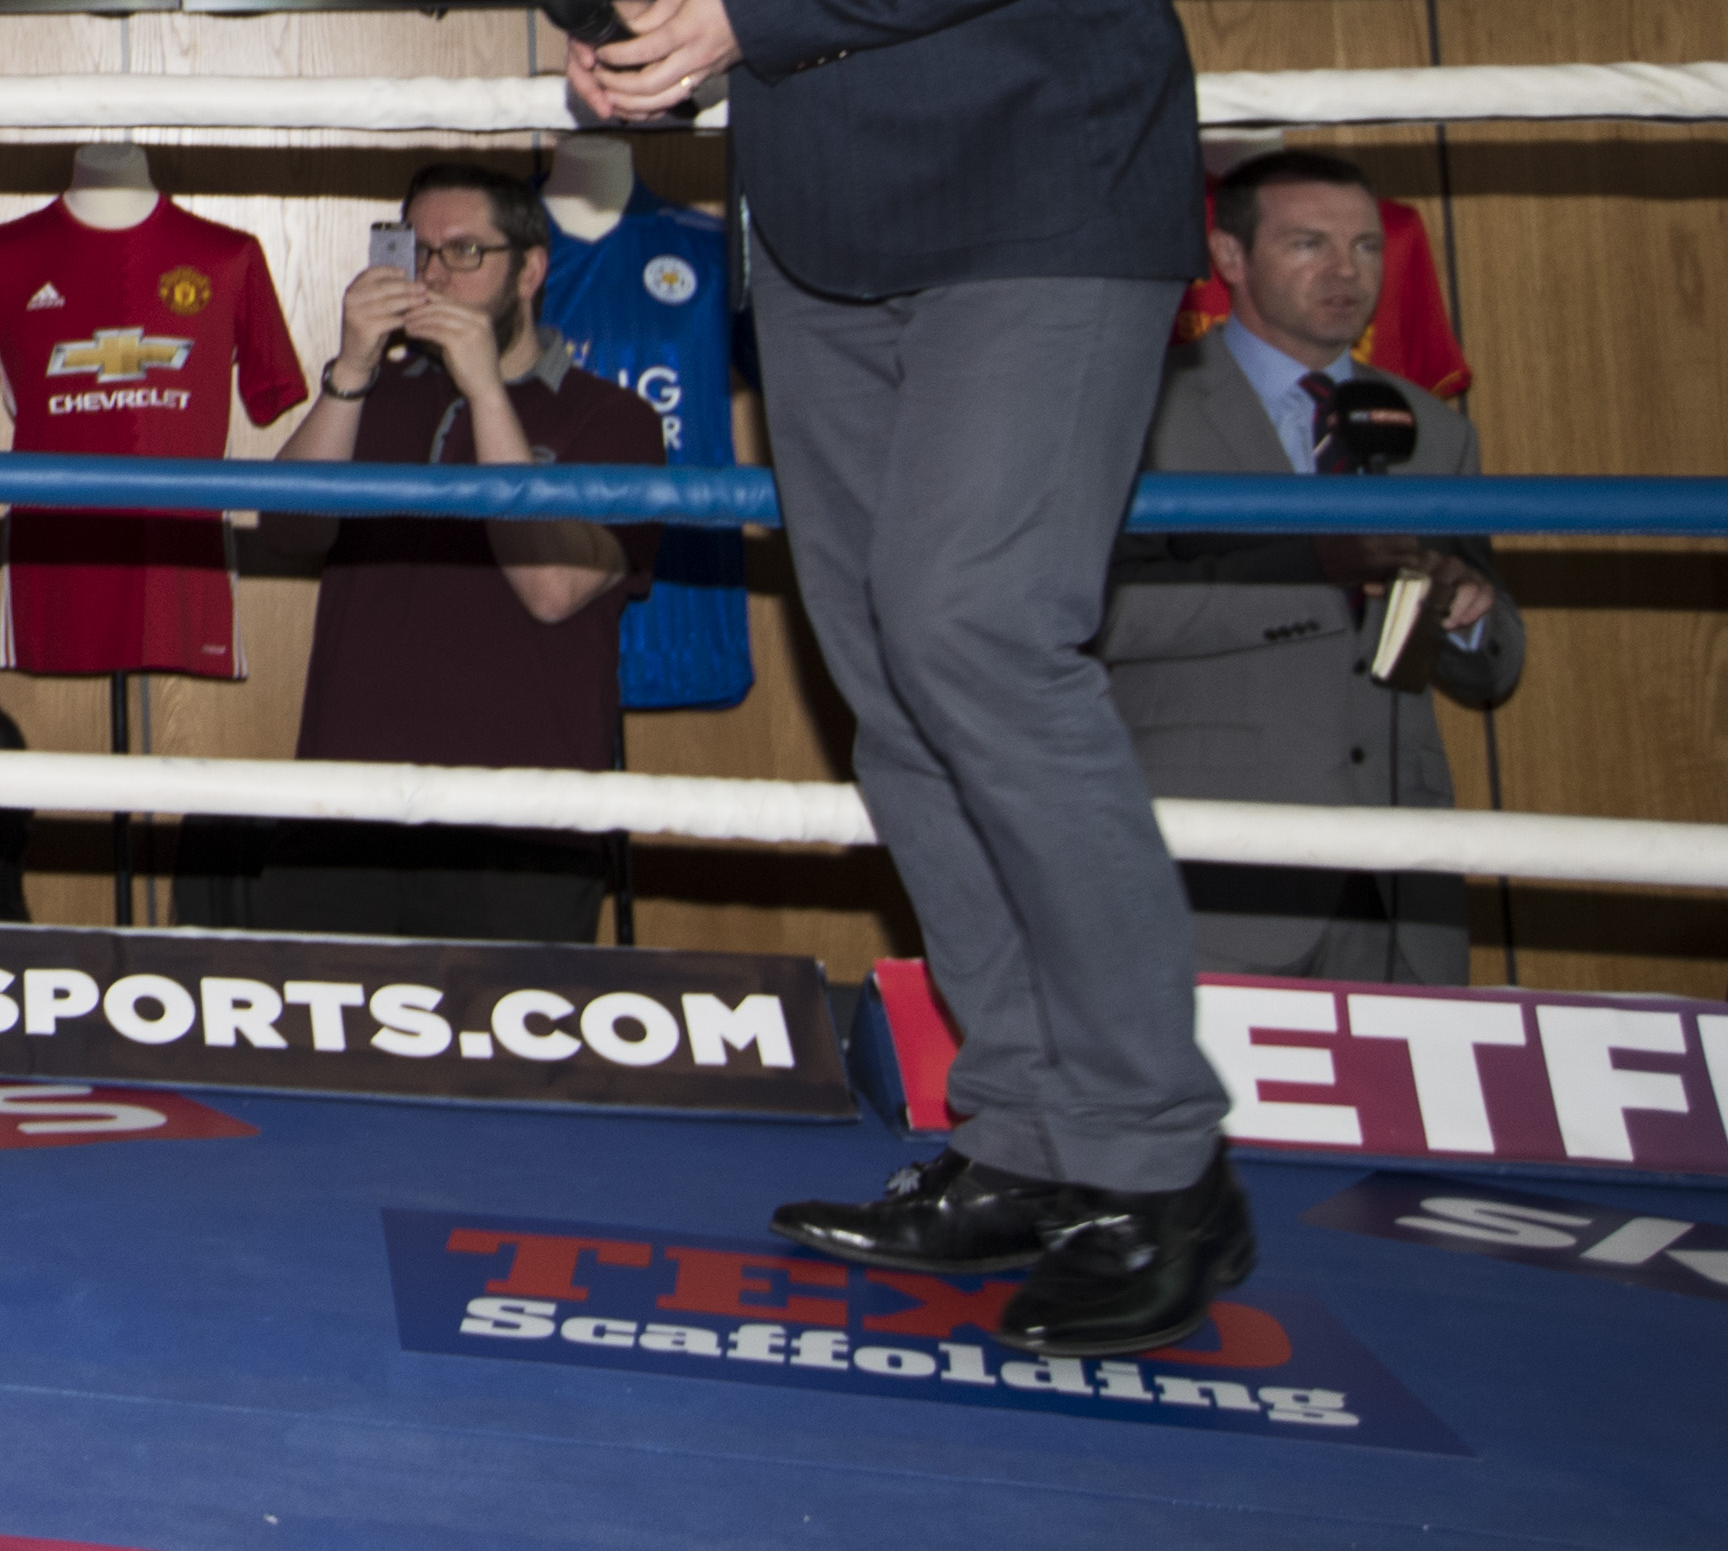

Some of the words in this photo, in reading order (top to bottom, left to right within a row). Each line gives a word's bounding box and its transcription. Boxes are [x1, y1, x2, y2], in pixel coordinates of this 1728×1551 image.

[48, 387, 192, 417] CHEVROLET
[1193, 985, 1728, 1162] ETF
[1393, 1196, 1728, 1287] sk
[459, 1296, 1361, 1428] Scaffolding
